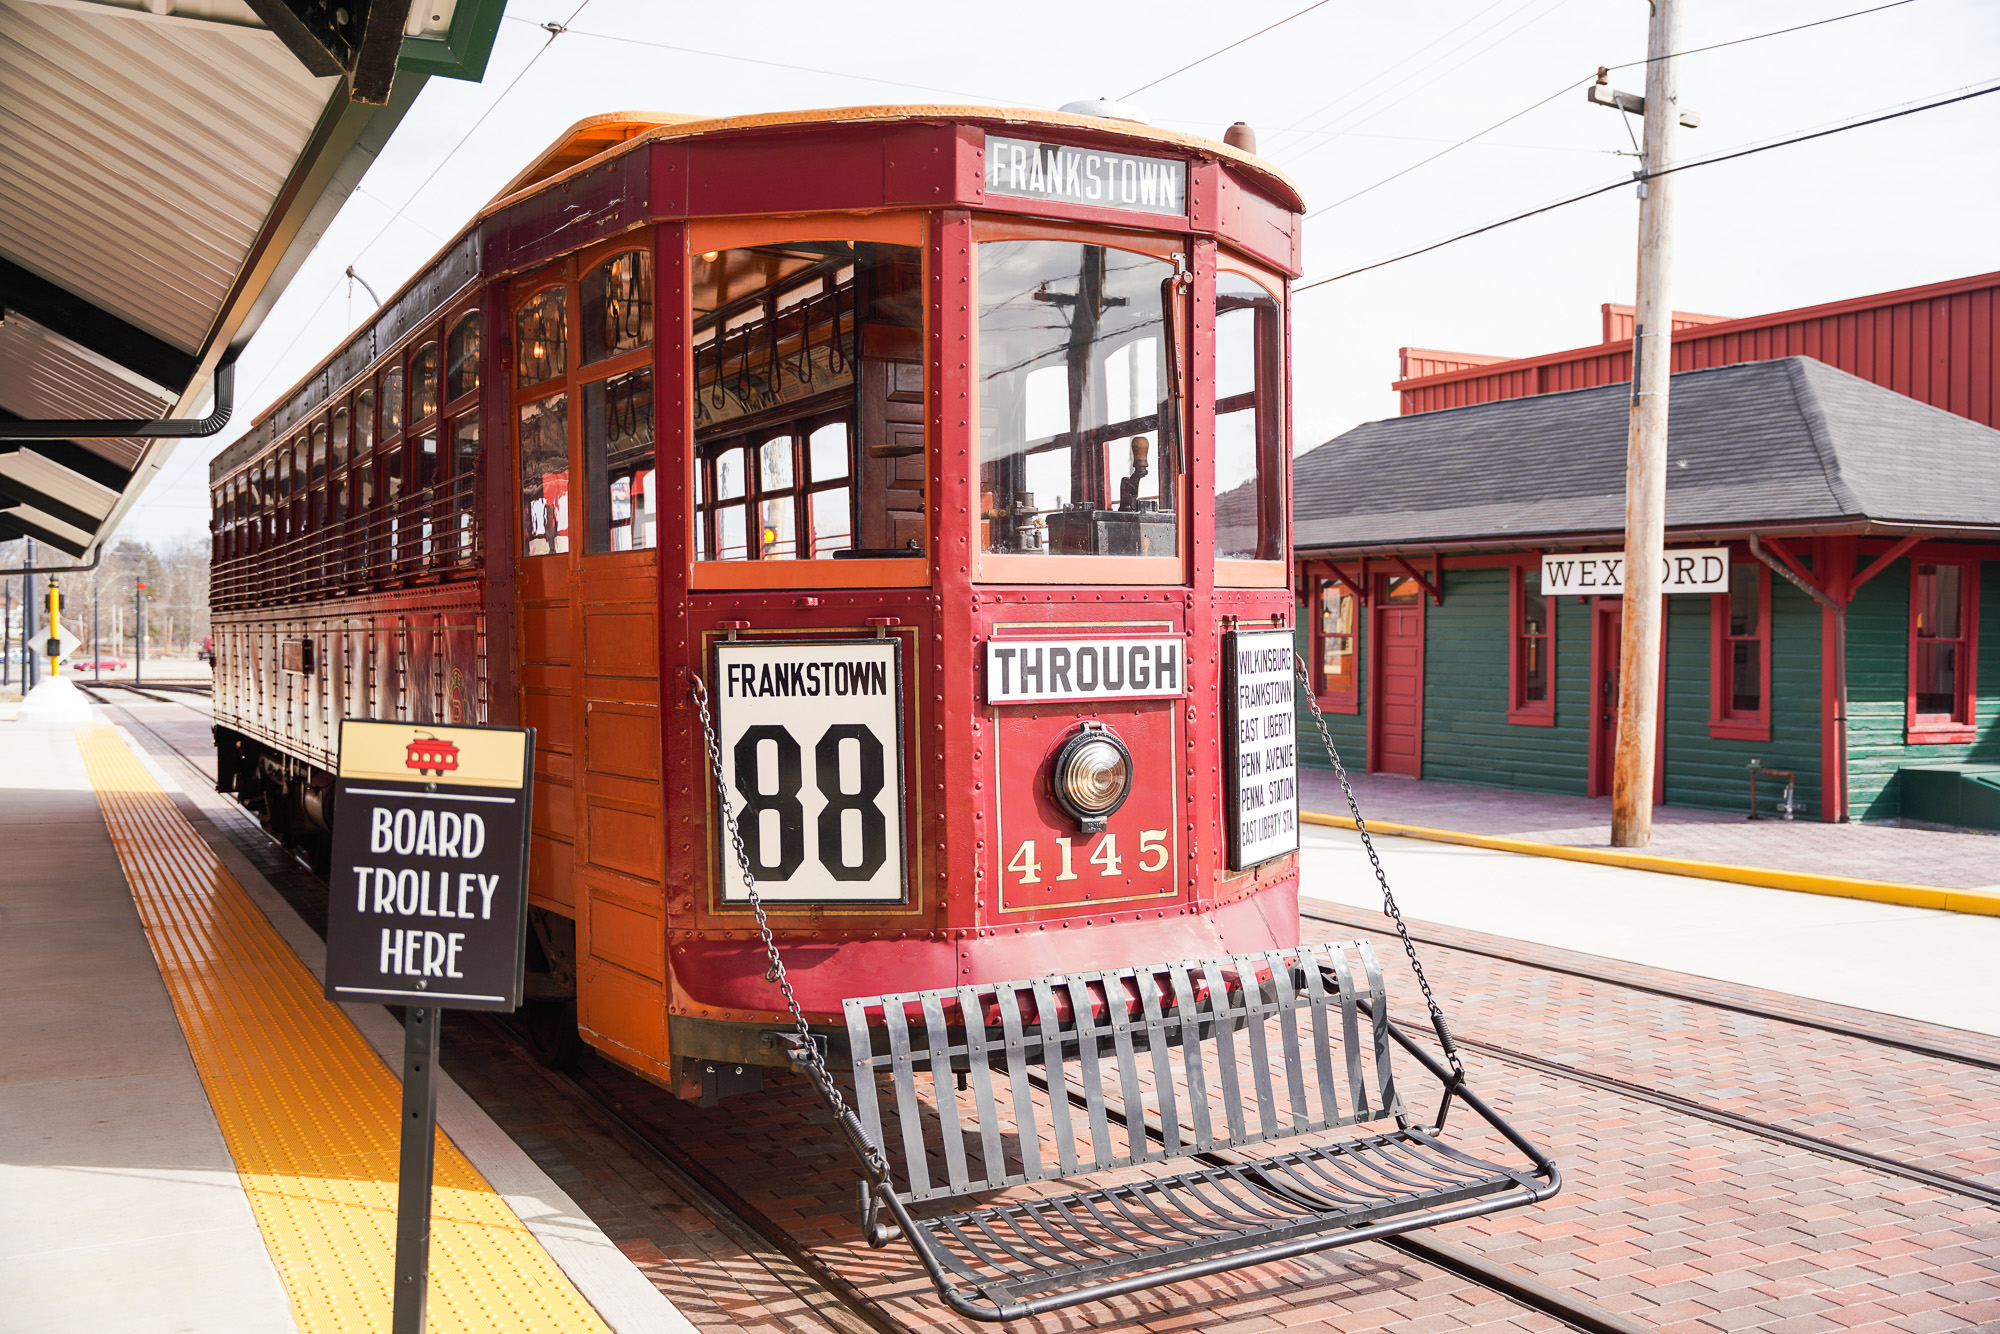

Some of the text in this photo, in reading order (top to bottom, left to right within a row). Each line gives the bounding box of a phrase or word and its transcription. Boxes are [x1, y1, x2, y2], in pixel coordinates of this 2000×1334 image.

[992, 142, 1176, 208] FRANKSTOWN
[1545, 556, 1724, 587] WEXRD
[727, 661, 887, 697] FRANKSTOWN
[994, 645, 1177, 695] THROUGH
[1239, 648, 1291, 675] WILKINSBURG
[1240, 680, 1292, 709] FRANKSTOWN
[1240, 712, 1292, 744] EAST LIBERTY
[1241, 744, 1293, 778] PENN AVENUE
[733, 724, 887, 881] 88
[1269, 776, 1294, 804] STATION
[370, 807, 486, 859] BOARD
[1242, 819, 1257, 846] EAST
[1258, 812, 1282, 841] LIBERTY
[1006, 828, 1170, 885] 4145
[352, 866, 500, 920] TROLLEY
[380, 928, 466, 978] HERE
